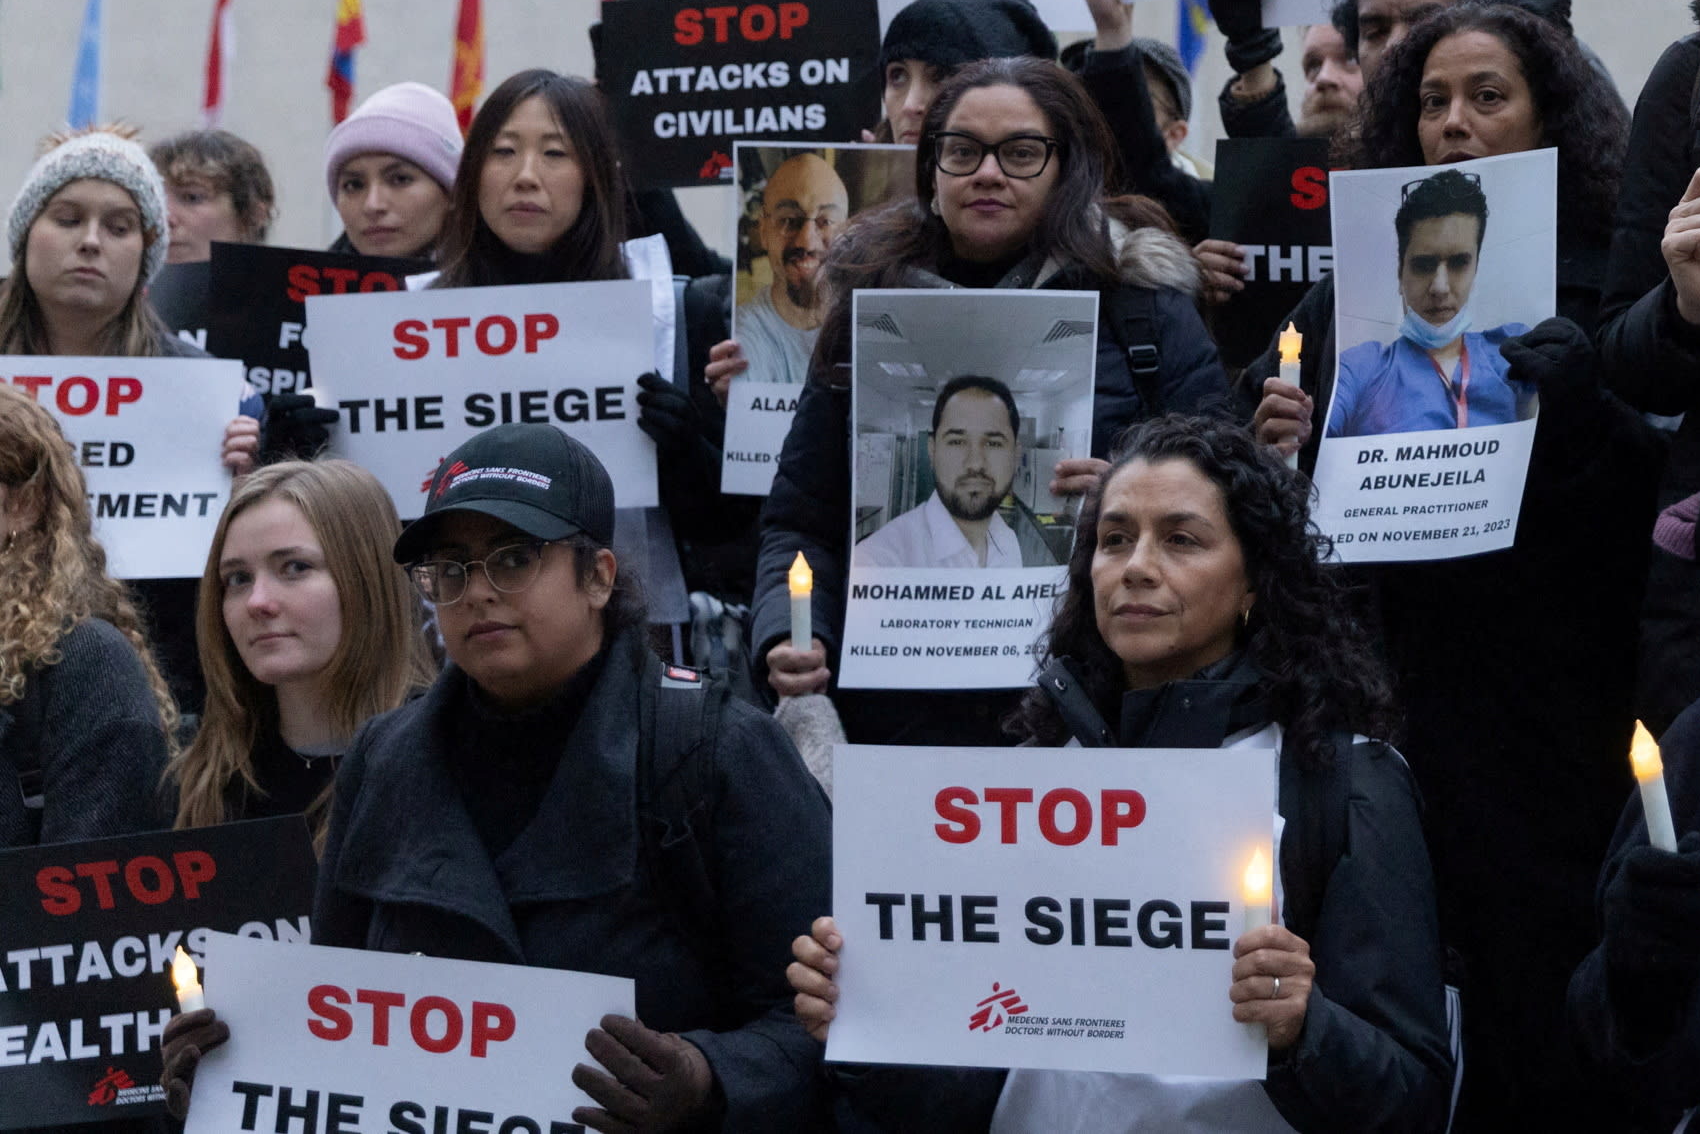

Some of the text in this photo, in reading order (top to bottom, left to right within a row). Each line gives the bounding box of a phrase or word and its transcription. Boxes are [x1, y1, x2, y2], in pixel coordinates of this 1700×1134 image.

[673, 2, 809, 46] STOP
[630, 58, 850, 97] ATTACKS ON
[653, 104, 827, 140] CIVILIANS
[1241, 245, 1334, 282] THE
[287, 264, 398, 303] STO
[393, 313, 560, 361] STOP
[0, 376, 143, 416] TOP
[339, 386, 626, 434] THE SIEGE
[751, 397, 798, 412] ALAA
[726, 451, 771, 463] KILLED
[1357, 439, 1500, 464] DR. MAHMOUD
[1359, 468, 1486, 491] ABUNEJEILA
[1344, 499, 1489, 518] GENERAL PRACTITIONER
[1358, 531, 1379, 542] ON
[1382, 528, 1459, 542] NOVEMBER
[1462, 526, 1480, 536] 21,
[1483, 518, 1511, 533] 2023
[852, 584, 974, 601] MOHAMMED
[981, 585, 1005, 600] AL
[880, 618, 1033, 629] LABORATORY TECHNICIAN
[850, 645, 1046, 658] KILLED ON NOVEMBER 06, 202
[934, 786, 1147, 846] STOP
[35, 851, 217, 917] STOP
[864, 892, 1231, 951] THE SIEGE
[0, 1007, 173, 1066] EALTH
[307, 984, 516, 1058] STOP
[1005, 1026, 1125, 1039] DOCTORS WITHOUT BORDERS
[1007, 1016, 1126, 1028] MEDECINS SANS FRONTIERES
[232, 1080, 586, 1134] THE SIE
